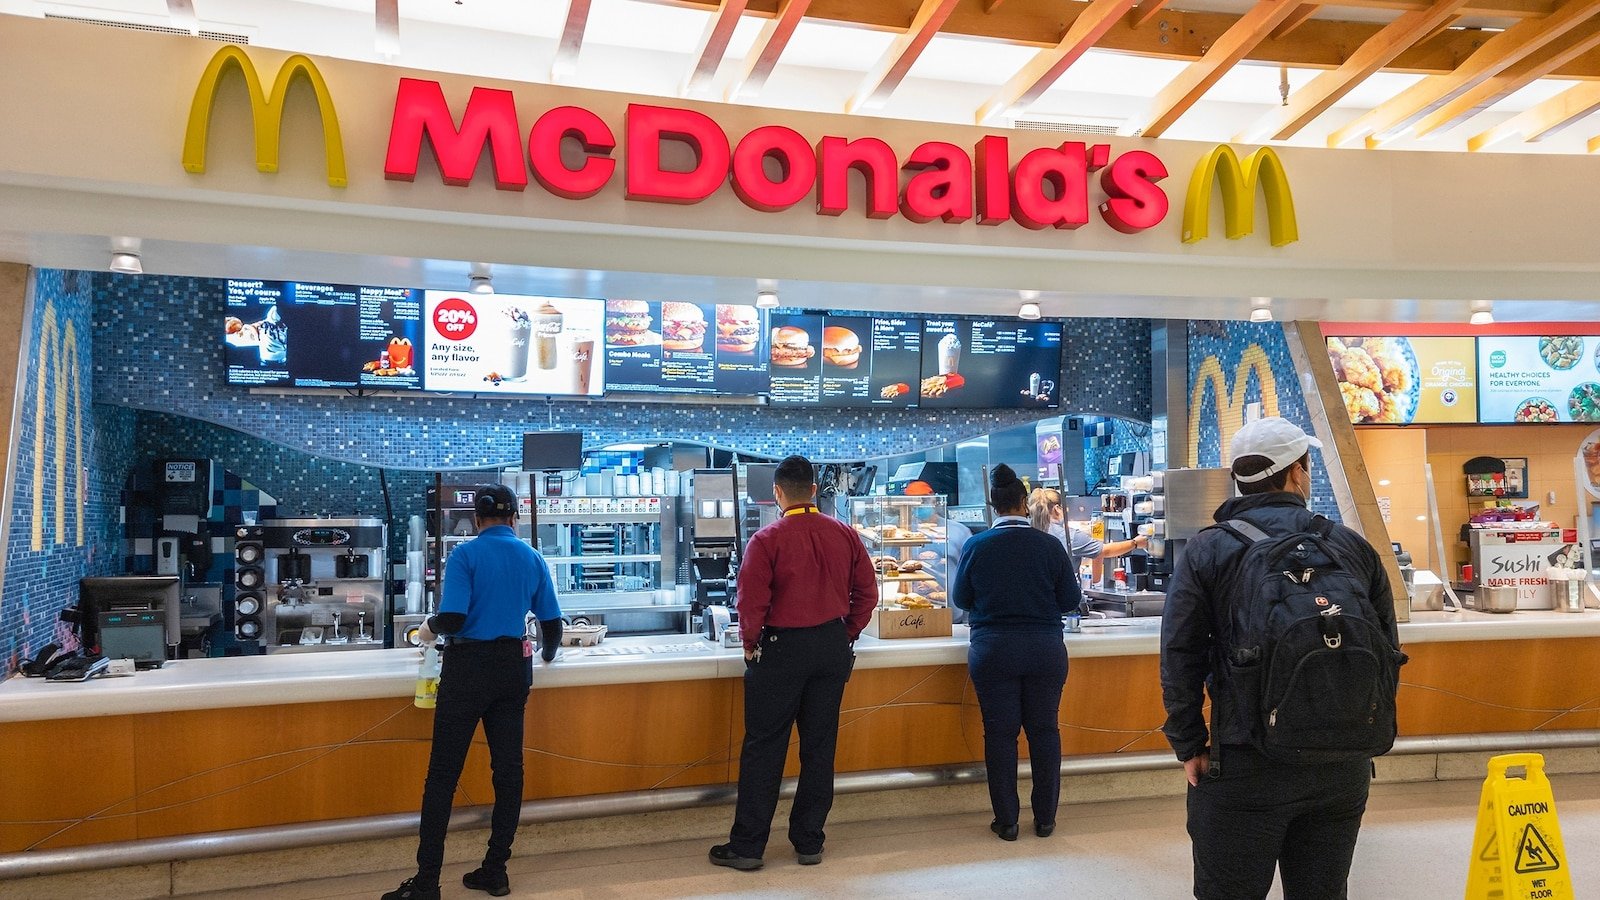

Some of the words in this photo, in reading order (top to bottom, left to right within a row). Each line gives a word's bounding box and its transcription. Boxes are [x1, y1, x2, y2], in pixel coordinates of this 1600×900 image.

[384, 77, 1169, 235] McDonald's
[228, 280, 263, 288] Dessert?
[295, 284, 334, 292] Beverages
[228, 287, 244, 296] Yes,
[361, 287, 383, 296] Happy
[438, 308, 475, 324] 20%
[446, 323, 465, 332] OFF
[432, 343, 450, 353] Any
[453, 344, 475, 353] size,
[432, 354, 449, 363] any
[452, 354, 480, 362] flavor
[1432, 366, 1466, 381] Original
[1491, 554, 1541, 574] Sushi
[1487, 578, 1516, 586] MADE
[1519, 577, 1548, 586] FRESH
[1518, 589, 1536, 599] ILY
[1508, 802, 1549, 816] CAUTION
[1531, 879, 1546, 888] WET
[1530, 890, 1552, 899] FLOOR
